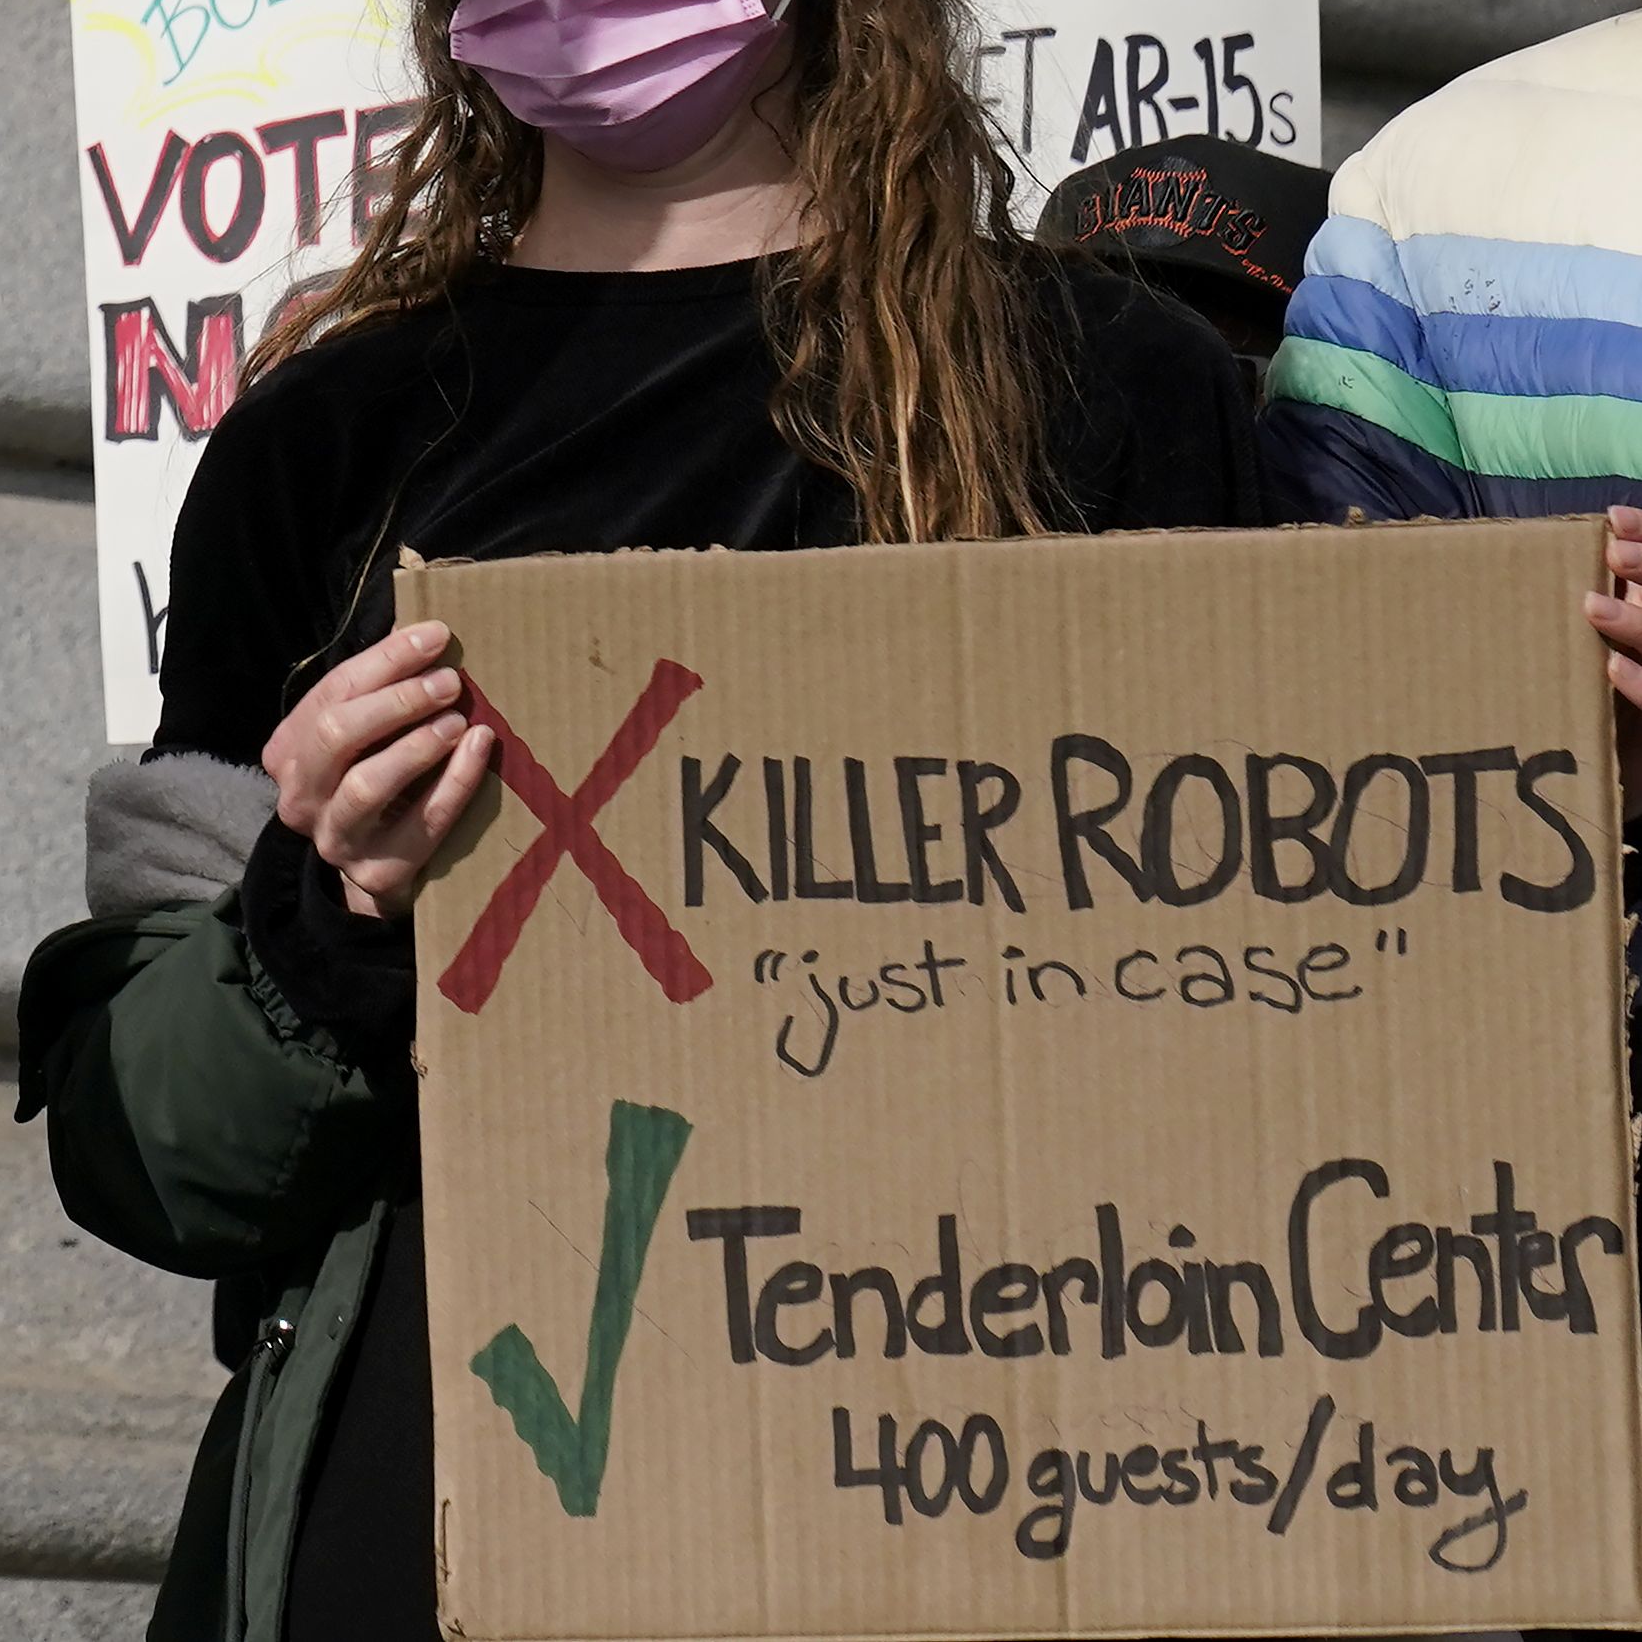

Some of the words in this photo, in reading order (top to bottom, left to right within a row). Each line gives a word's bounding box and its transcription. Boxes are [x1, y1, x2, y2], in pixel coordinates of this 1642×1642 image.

[1074, 166, 1269, 256] GIANTS
[681, 746, 1027, 915] KILLER
[1050, 733, 1599, 915] ROBOTS
[752, 946, 966, 1079] "just
[1004, 946, 1087, 1006] in
[1115, 927, 1409, 1014] case"
[685, 1203, 1285, 1367] Tenderloin
[1289, 1157, 1624, 1360] Center
[831, 1406, 1010, 1526] 400
[1015, 1394, 1529, 1573] guests/day
